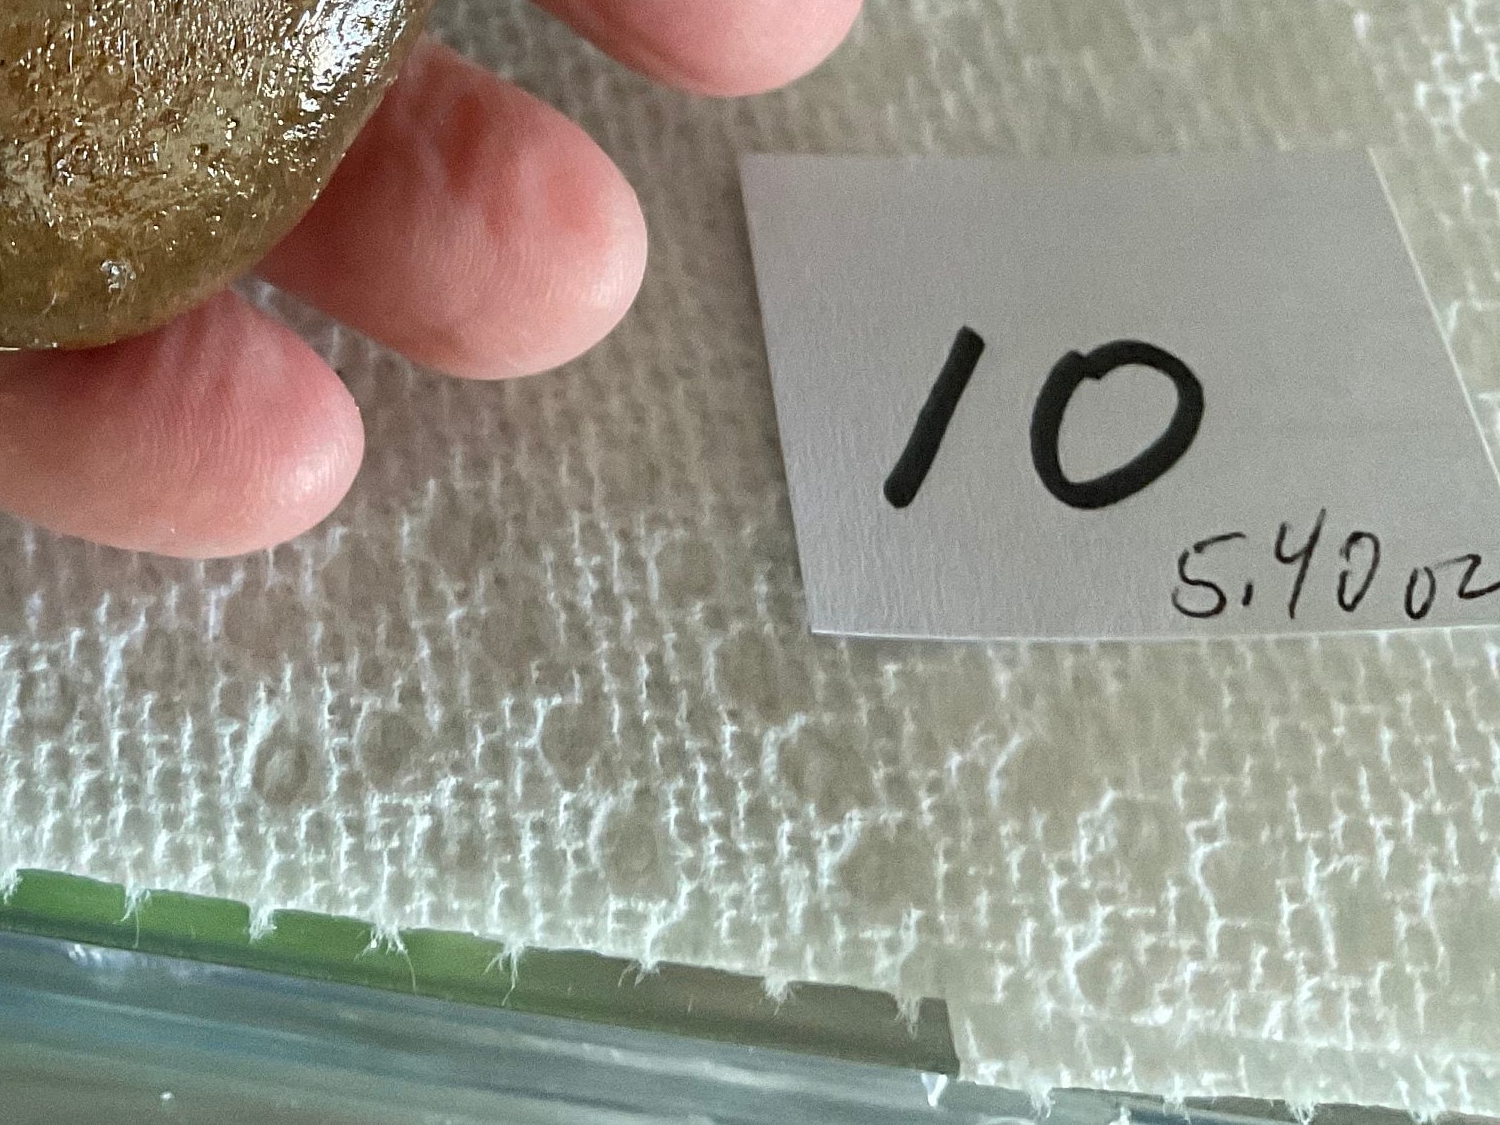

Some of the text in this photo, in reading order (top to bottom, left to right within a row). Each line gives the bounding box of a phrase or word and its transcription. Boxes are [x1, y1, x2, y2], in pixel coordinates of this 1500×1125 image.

[882, 325, 1206, 511] 10
[1171, 508, 1500, 620] 5.40 oz
